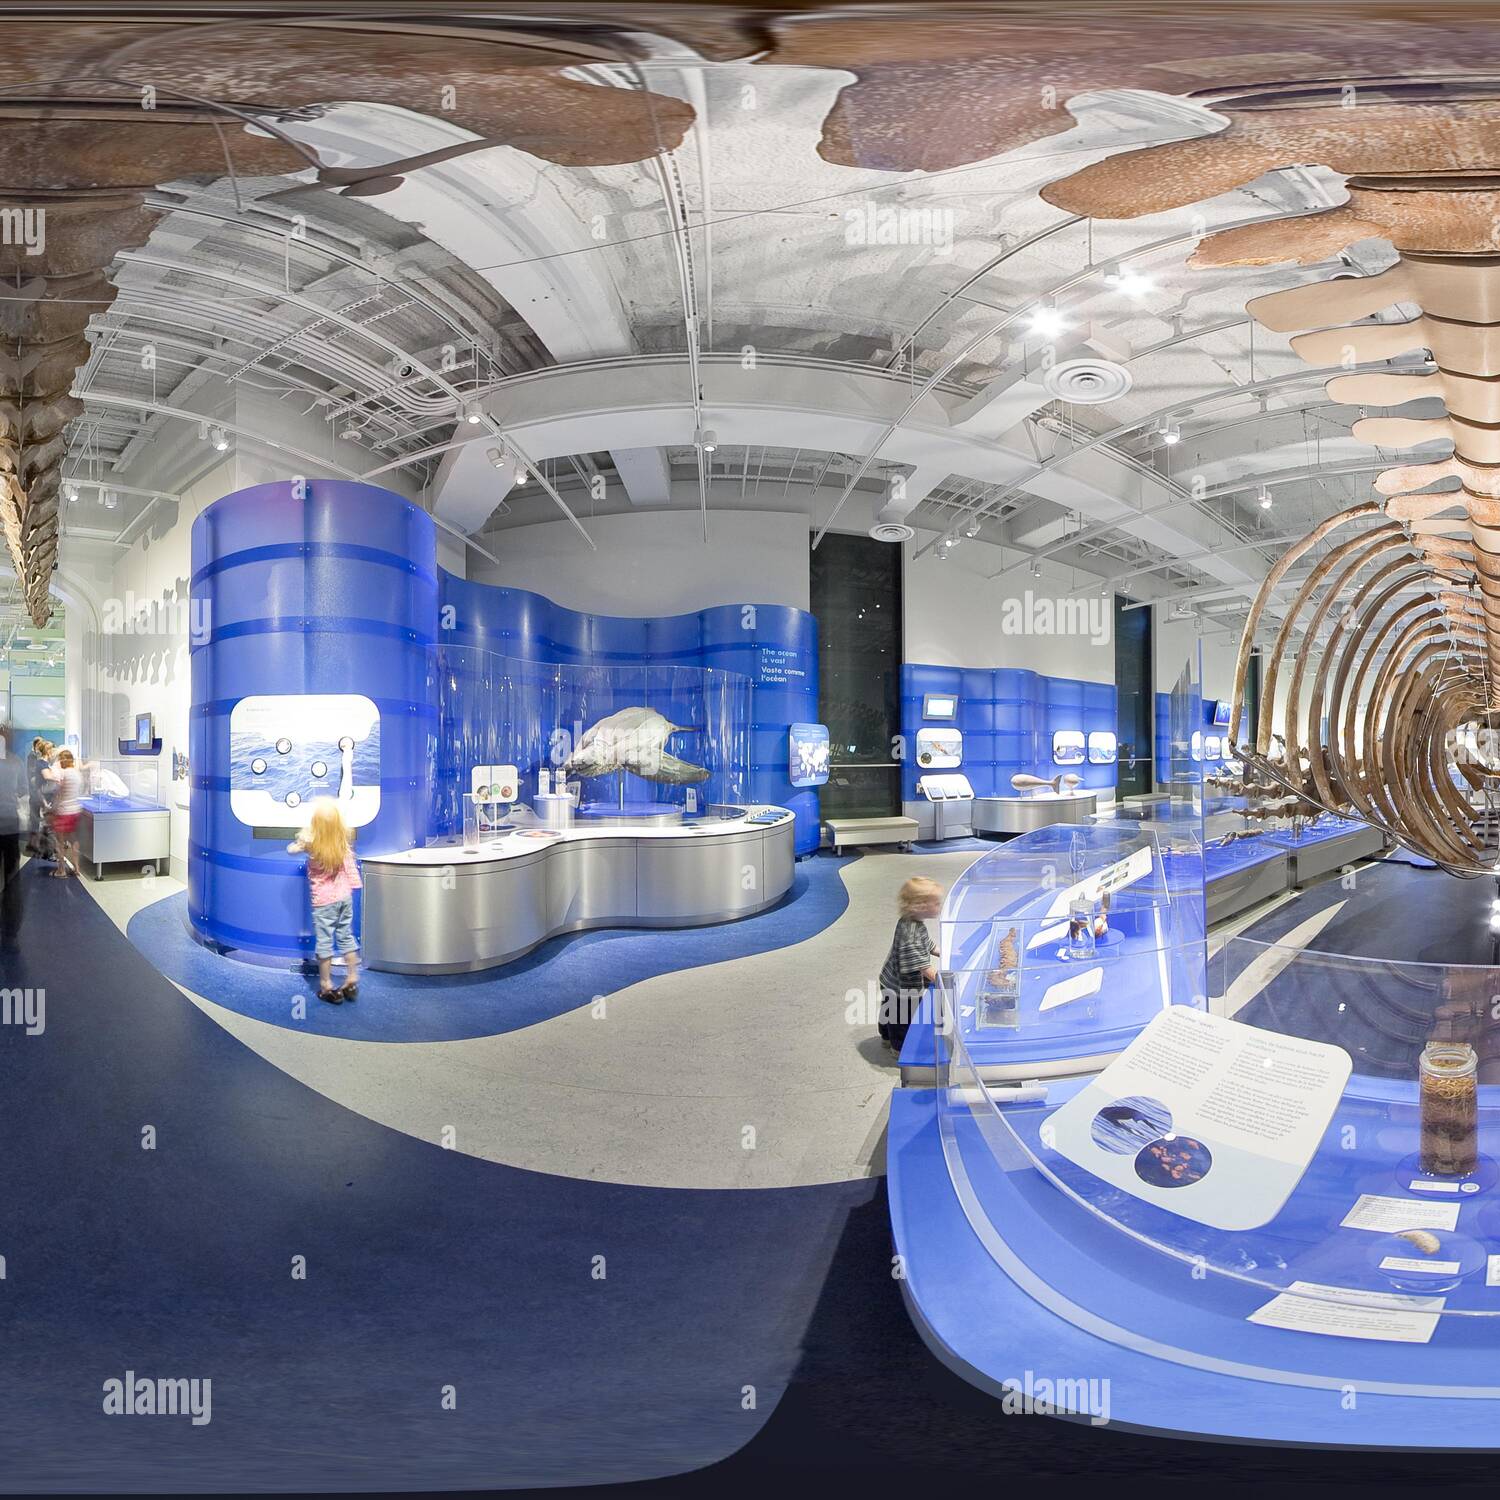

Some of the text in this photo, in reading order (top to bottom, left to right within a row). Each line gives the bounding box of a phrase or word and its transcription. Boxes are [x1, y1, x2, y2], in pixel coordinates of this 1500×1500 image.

[761, 648, 798, 658] The ocean
[761, 656, 768, 664] is
[761, 666, 806, 677] Vaste comme
[761, 674, 787, 683] l'océan
